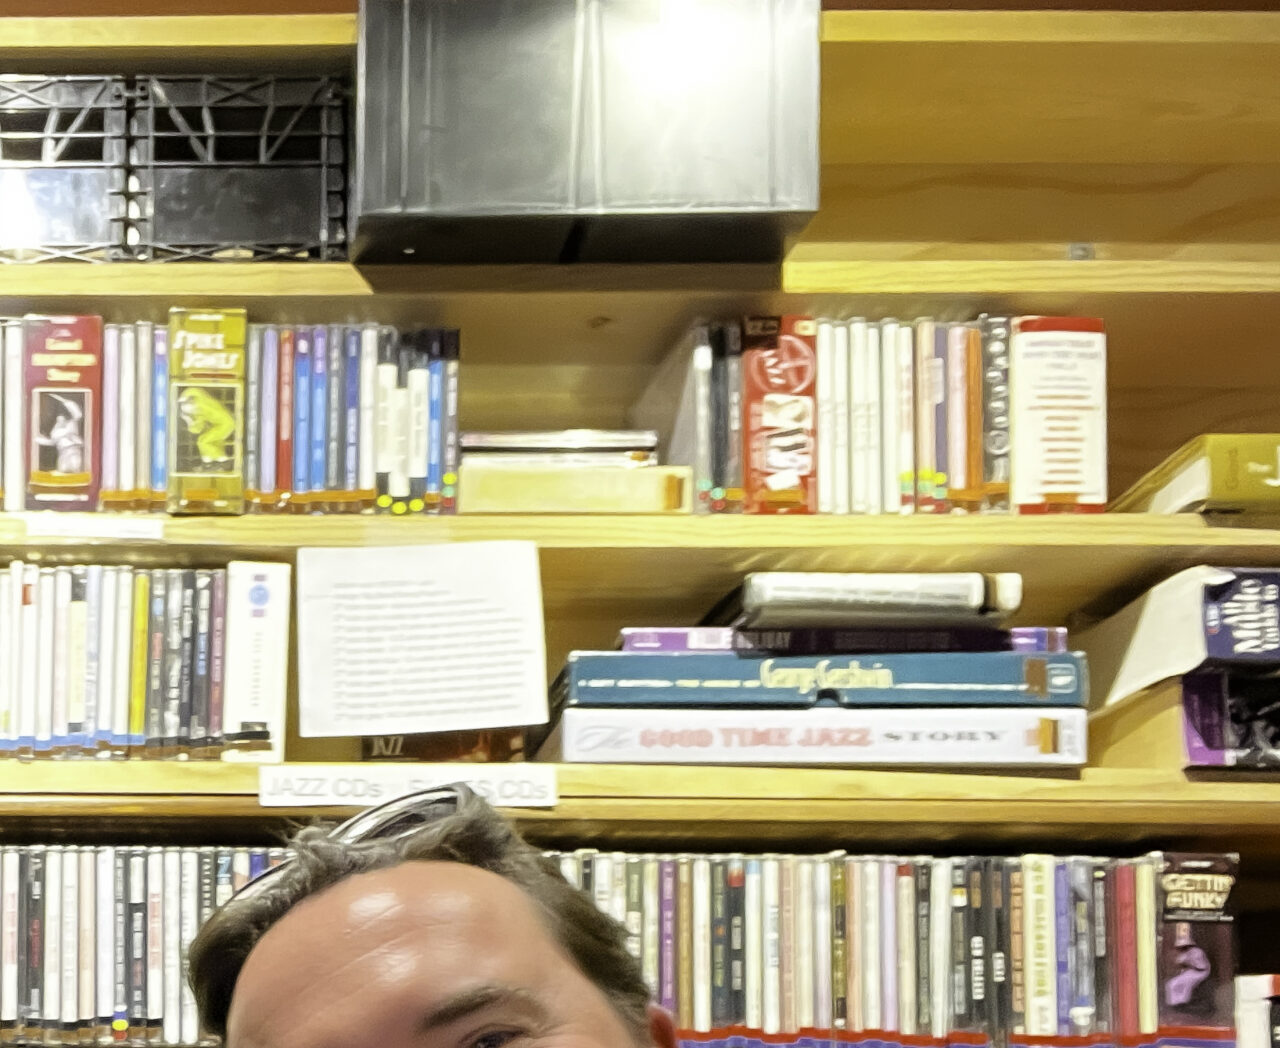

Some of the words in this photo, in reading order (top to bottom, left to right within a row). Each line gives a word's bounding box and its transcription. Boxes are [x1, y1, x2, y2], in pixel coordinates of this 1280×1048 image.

[798, 727, 873, 747] JAZZ
[883, 731, 1001, 742] STORY
[268, 777, 328, 797] JAZZ
[331, 778, 384, 798] CDs
[499, 780, 547, 799] CDs
